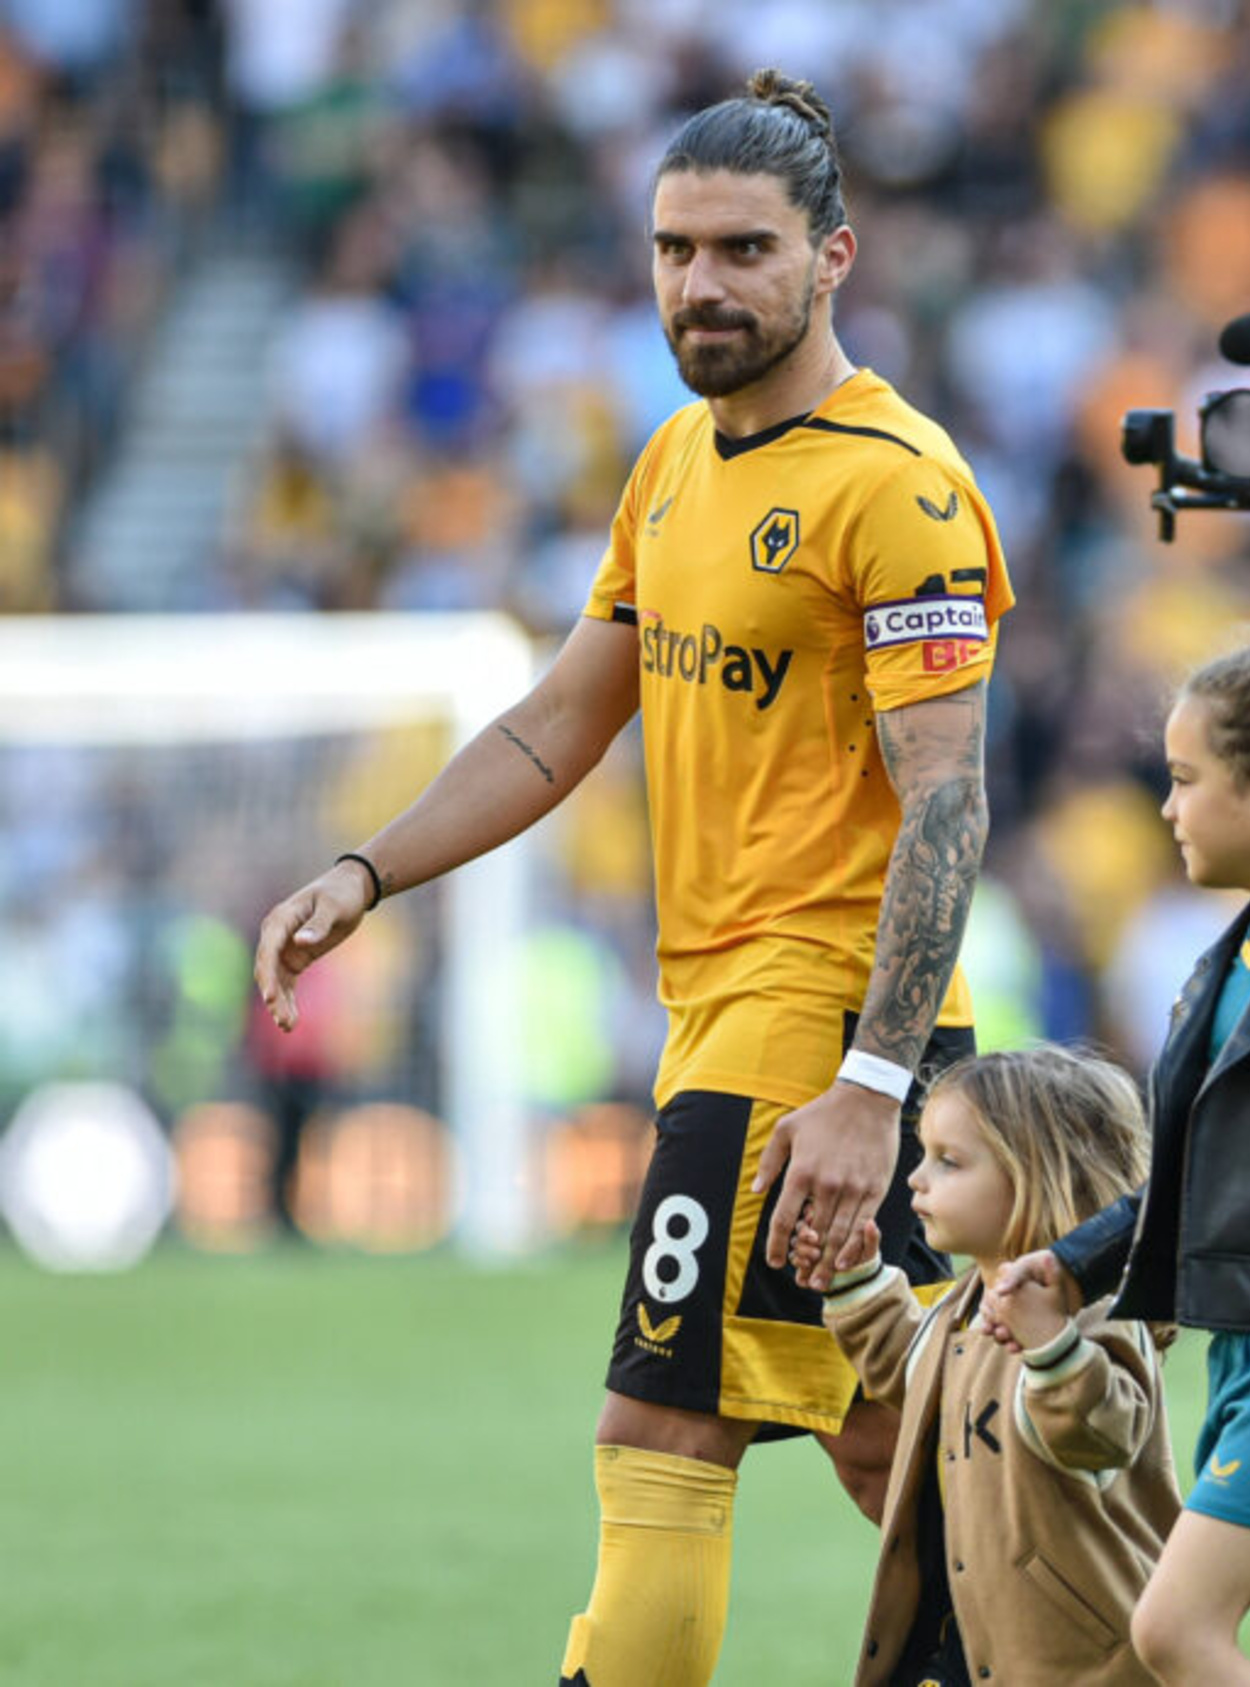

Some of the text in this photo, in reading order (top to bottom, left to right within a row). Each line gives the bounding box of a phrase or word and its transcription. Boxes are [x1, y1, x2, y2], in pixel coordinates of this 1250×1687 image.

[642, 610, 794, 711] stroPay
[643, 1194, 709, 1302] 8
[964, 1399, 1002, 1459] K
